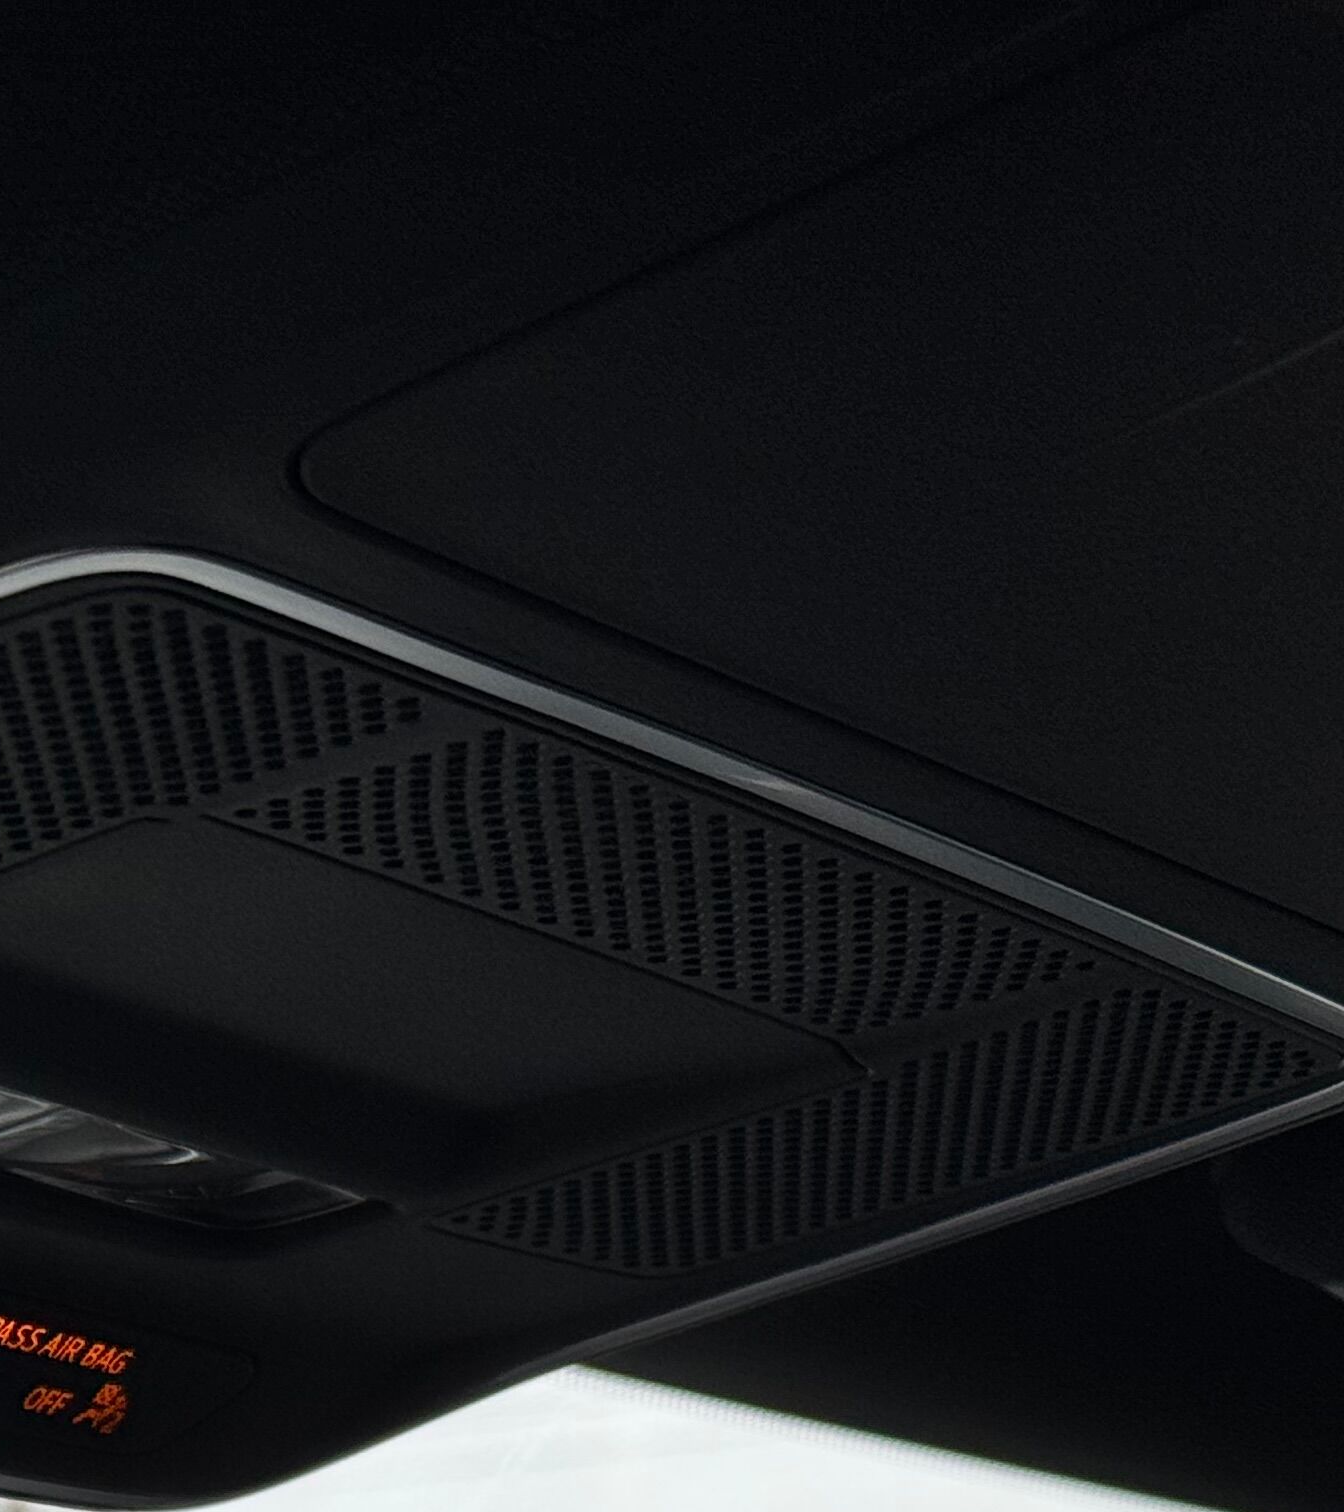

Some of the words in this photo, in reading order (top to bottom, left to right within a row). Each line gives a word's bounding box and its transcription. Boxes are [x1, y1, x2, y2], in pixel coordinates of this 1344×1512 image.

[37, 1332, 86, 1362] AIR
[80, 1343, 135, 1374] BAG
[23, 1387, 74, 1415] OFF
